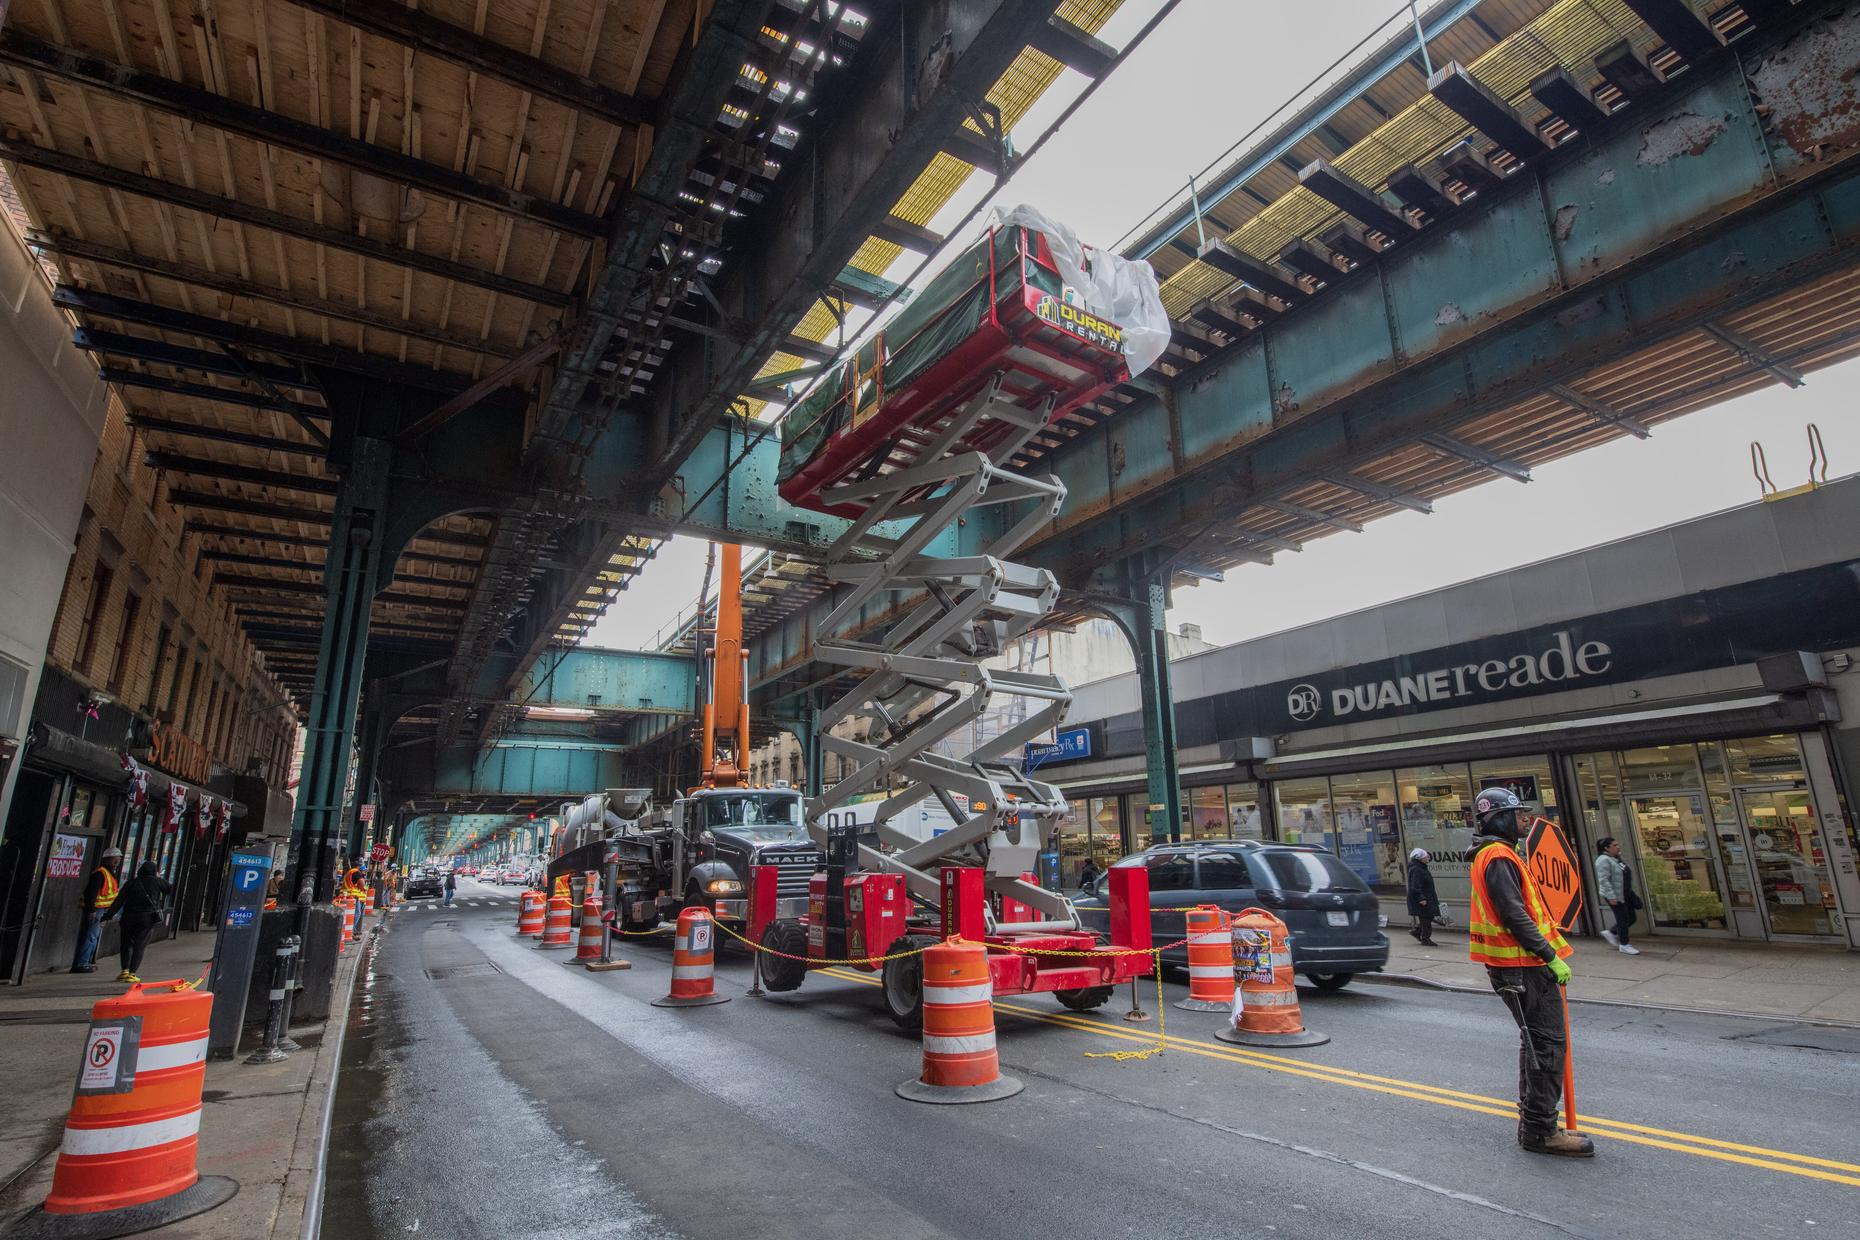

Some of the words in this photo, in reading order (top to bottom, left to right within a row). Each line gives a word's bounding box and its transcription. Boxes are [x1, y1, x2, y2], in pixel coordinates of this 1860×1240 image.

[1060, 303, 1123, 343] DURAN
[372, 847, 390, 858] STOP
[766, 856, 819, 864] MACK
[243, 870, 259, 888] P
[1536, 851, 1571, 895] SLOW
[95, 1044, 108, 1062] P
